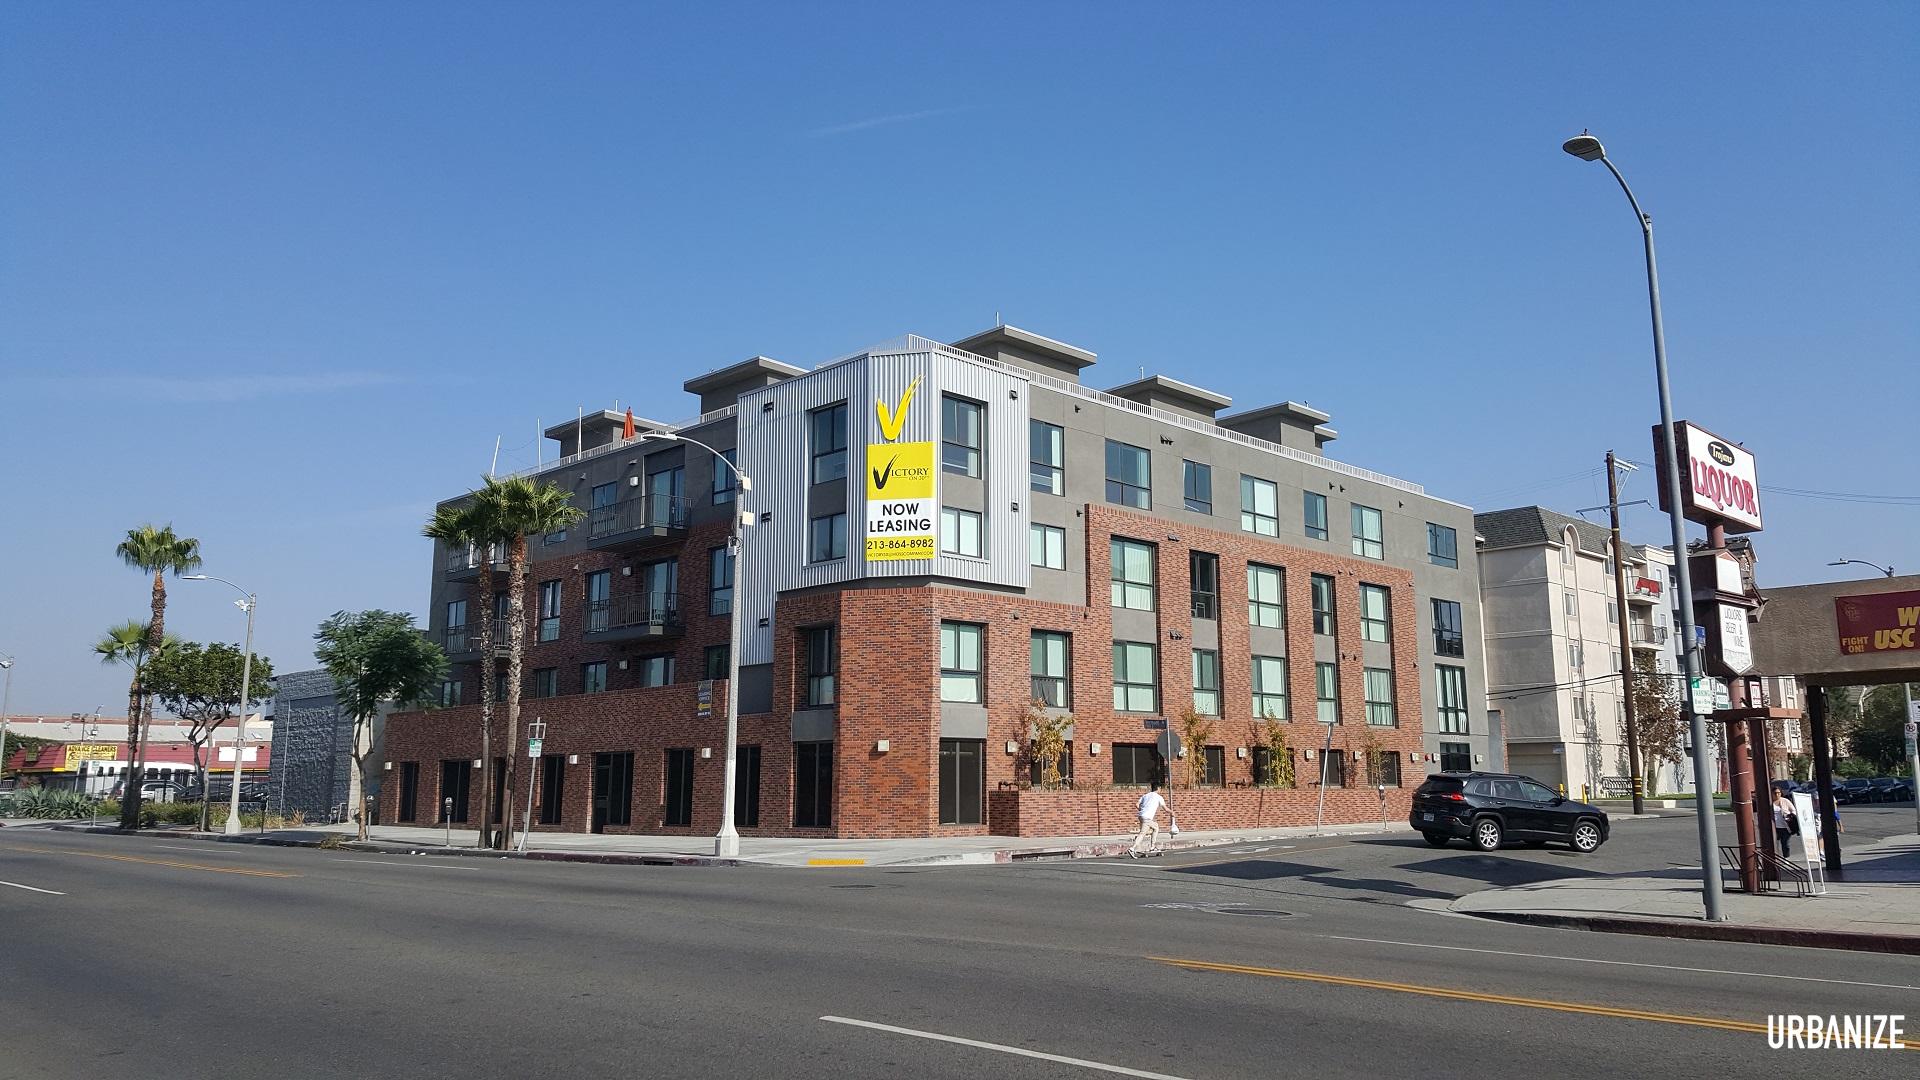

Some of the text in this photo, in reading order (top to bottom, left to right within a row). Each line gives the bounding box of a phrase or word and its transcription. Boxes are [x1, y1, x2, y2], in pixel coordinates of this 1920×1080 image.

[1710, 443, 1733, 463] Trojans
[873, 453, 930, 490] VICTORY
[1691, 456, 1758, 517] LIQUOR
[882, 503, 919, 516] NOW
[869, 518, 931, 533] LEASING
[867, 538, 934, 550] 213-864-8982
[1841, 636, 1869, 646] FIGHT
[1874, 628, 1916, 650] USC
[1848, 645, 1865, 653] ON!
